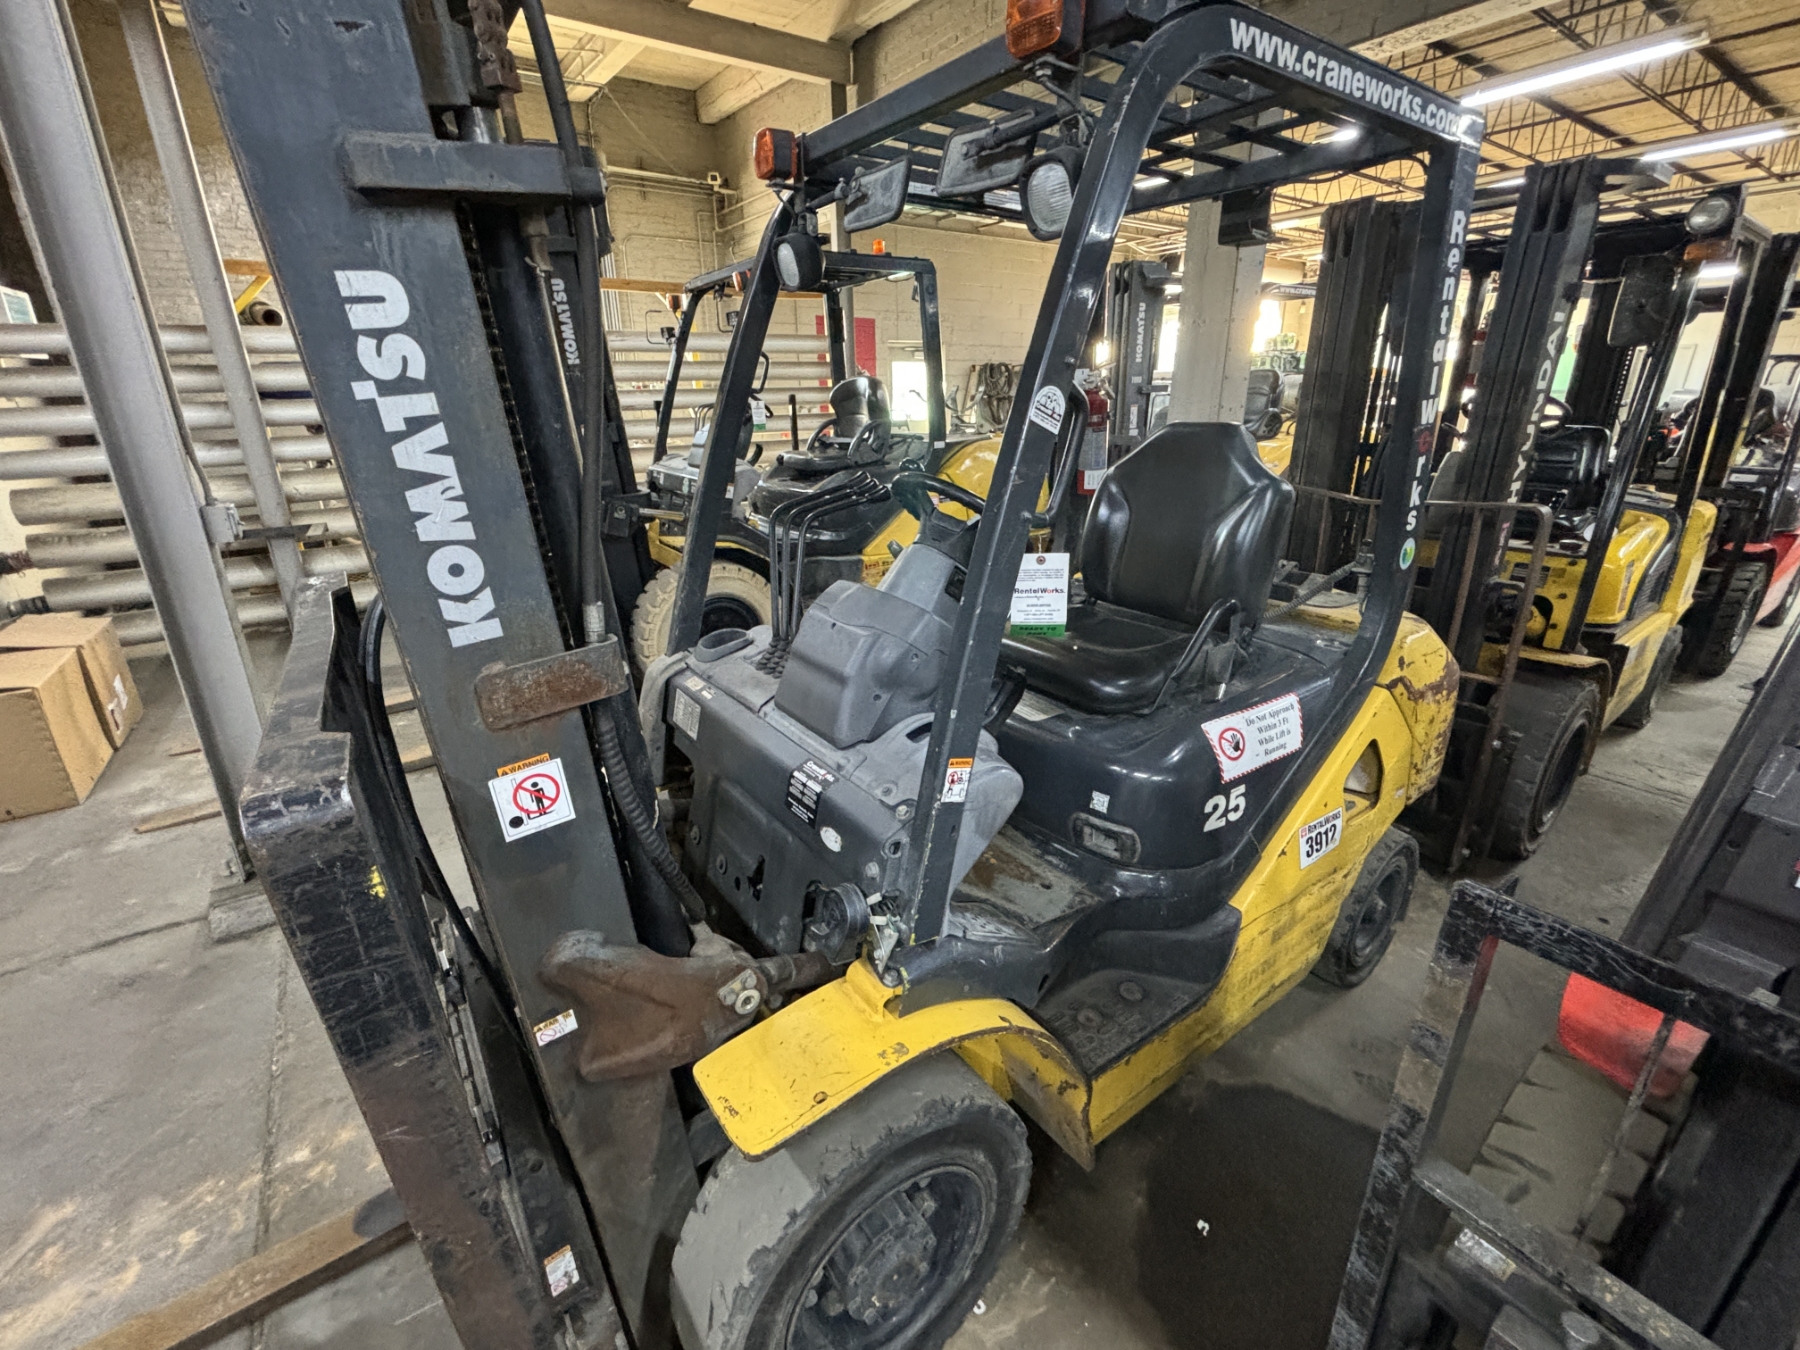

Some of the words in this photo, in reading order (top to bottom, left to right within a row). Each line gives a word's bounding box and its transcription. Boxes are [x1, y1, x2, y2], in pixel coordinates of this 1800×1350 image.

[550, 278, 581, 365] KOMATSU
[1135, 302, 1147, 363] KOMATSU
[1507, 311, 1566, 504] HYUNDAI
[334, 270, 504, 648] KOMATSU
[1245, 718, 1256, 727] Do
[1256, 713, 1267, 724] Not
[1268, 702, 1295, 719] Approach
[1257, 722, 1278, 734] Within
[1258, 734, 1275, 746] While
[1275, 730, 1286, 741] Lift
[1264, 742, 1287, 756] Running
[508, 755, 549, 773] WARNING
[1203, 784, 1246, 832] 25
[1305, 823, 1337, 858] 3912
